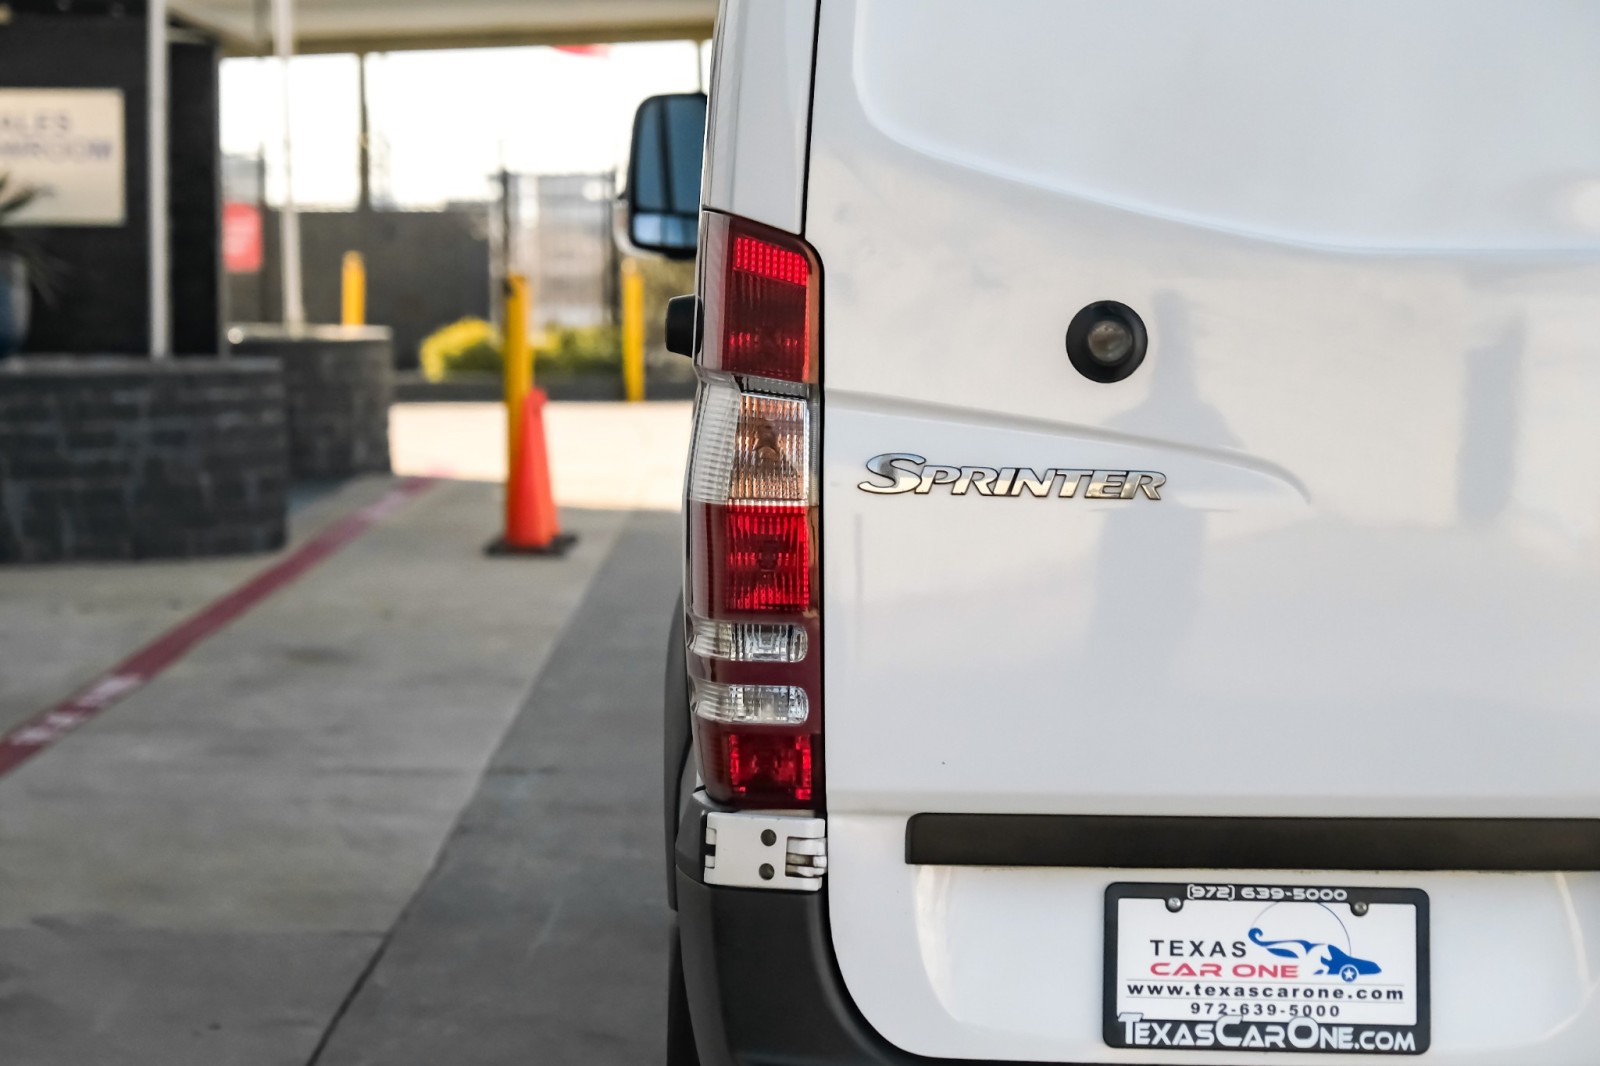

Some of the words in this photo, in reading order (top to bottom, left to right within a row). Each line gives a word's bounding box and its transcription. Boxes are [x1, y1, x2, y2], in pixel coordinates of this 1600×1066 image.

[857, 452, 1167, 501] SPRINTER
[1241, 886, 1348, 901] 639-5000
[1150, 939, 1247, 958] TEXAS
[1150, 962, 1222, 978] CAR
[1232, 964, 1299, 979] ONE
[1127, 983, 1404, 1001] www.texascarone.com
[1191, 1002, 1340, 1018] 972-639-5000
